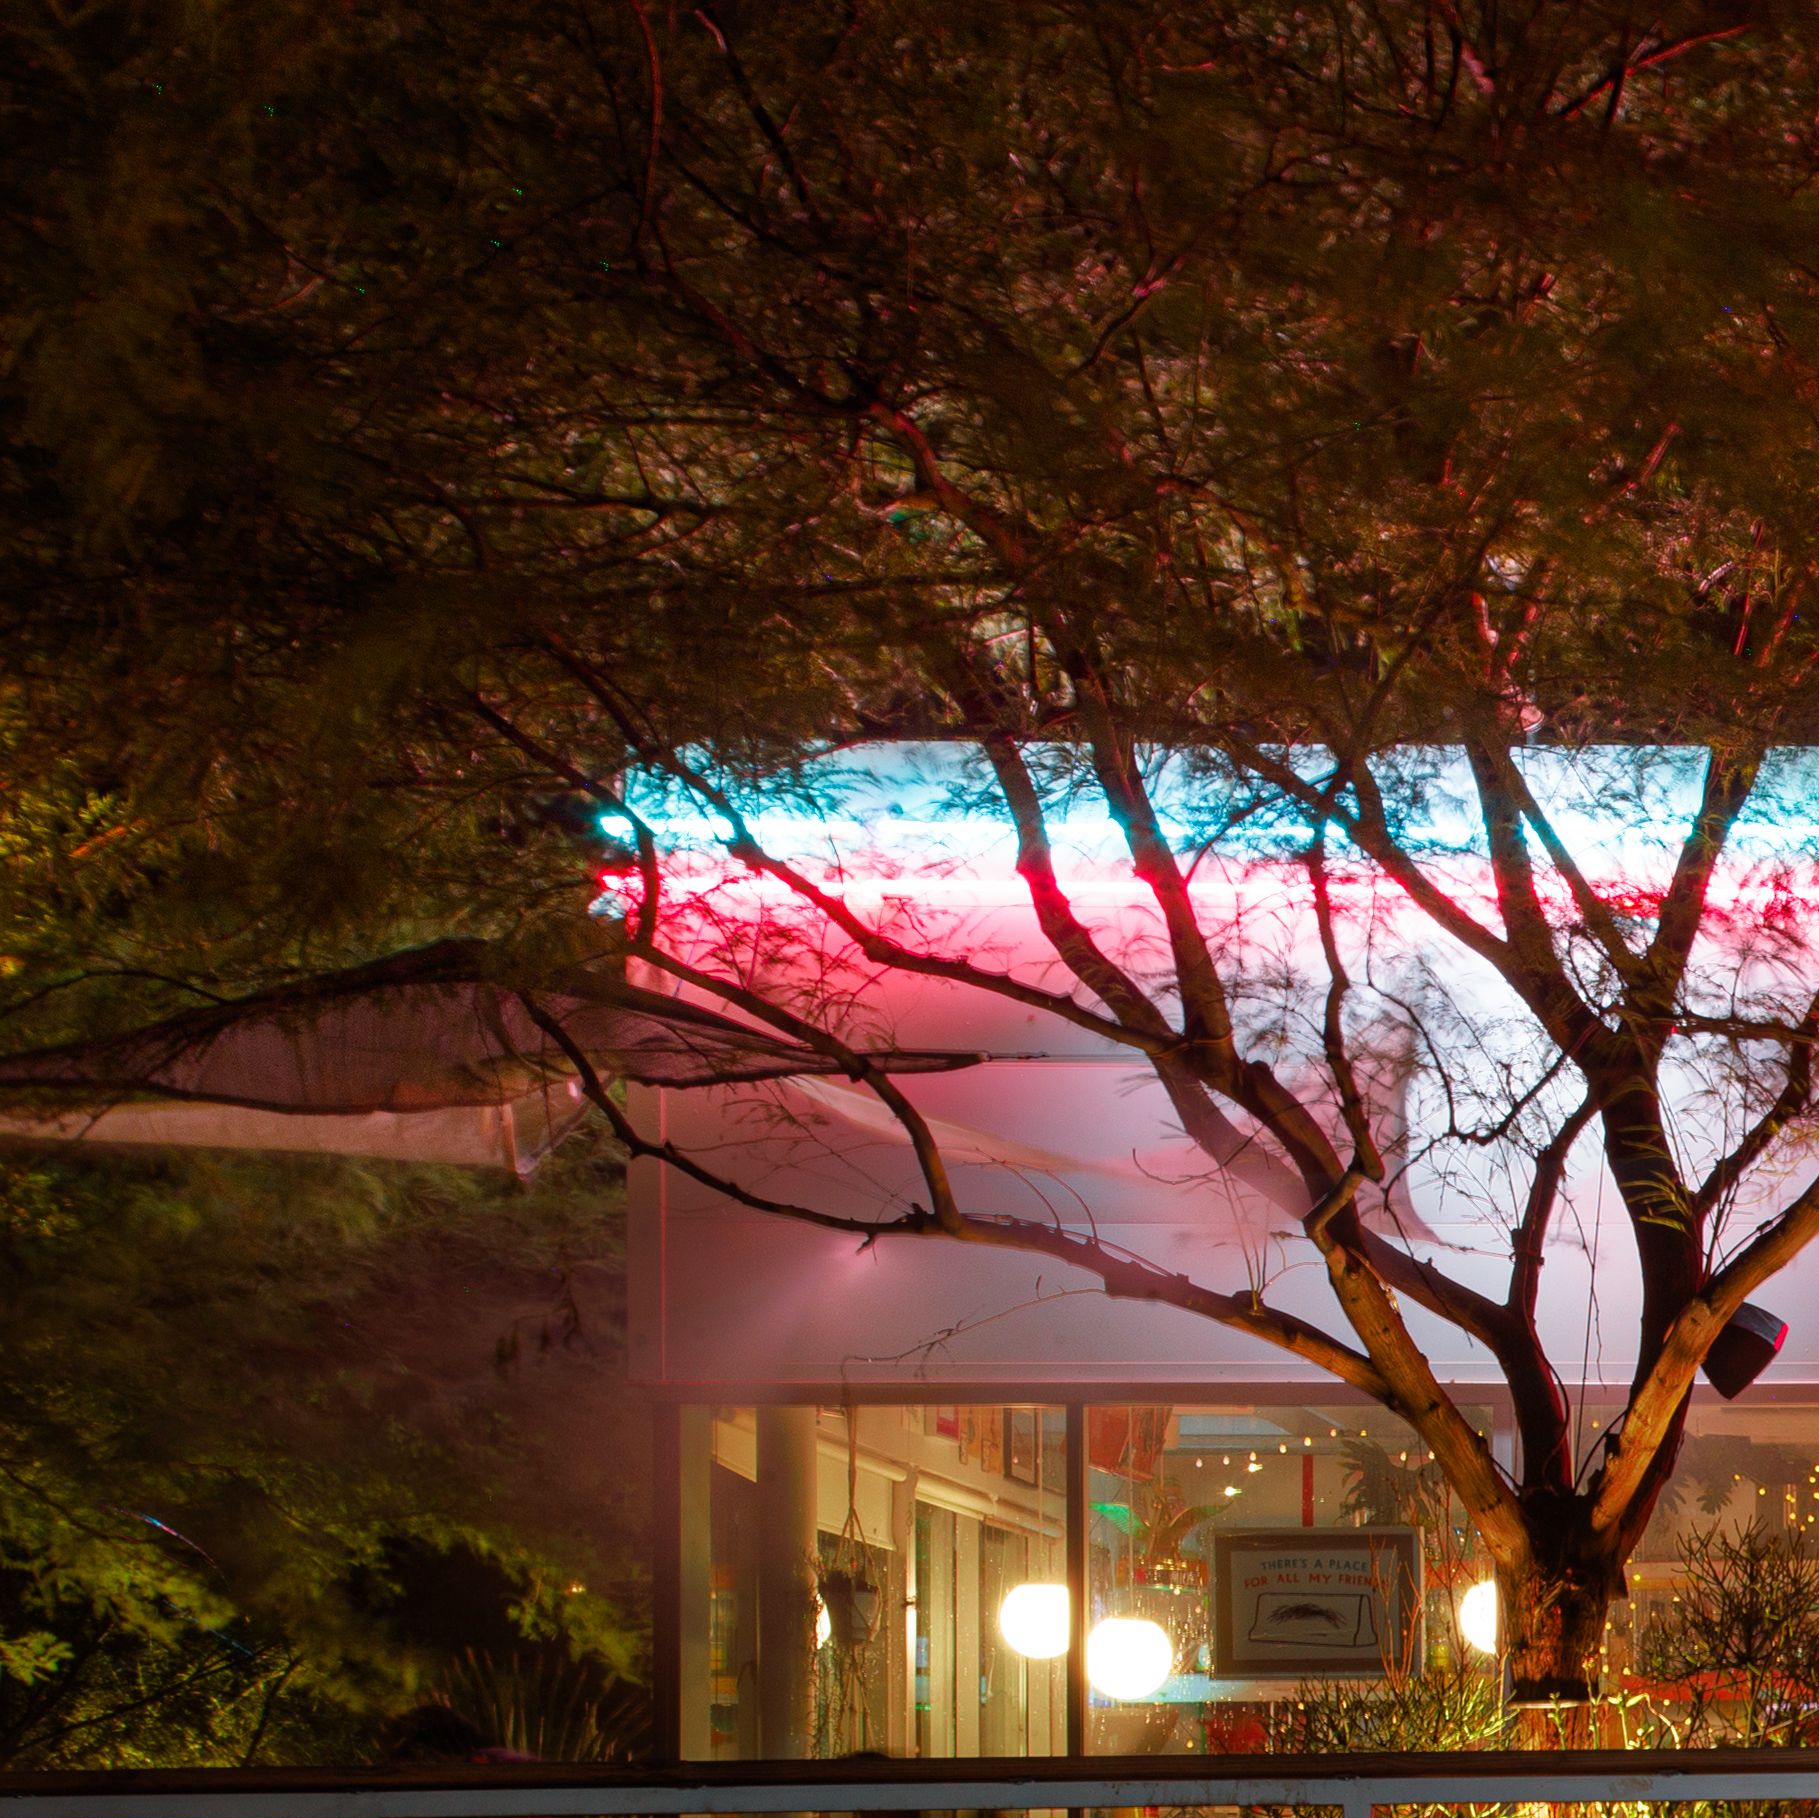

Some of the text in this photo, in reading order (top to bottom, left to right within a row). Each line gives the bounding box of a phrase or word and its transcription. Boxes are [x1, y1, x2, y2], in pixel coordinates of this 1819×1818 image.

[1260, 1558, 1368, 1571] THERE'S A PLACE
[1244, 1575, 1269, 1588] FOR
[1276, 1572, 1300, 1584] ALL
[1308, 1573, 1332, 1584] MY
